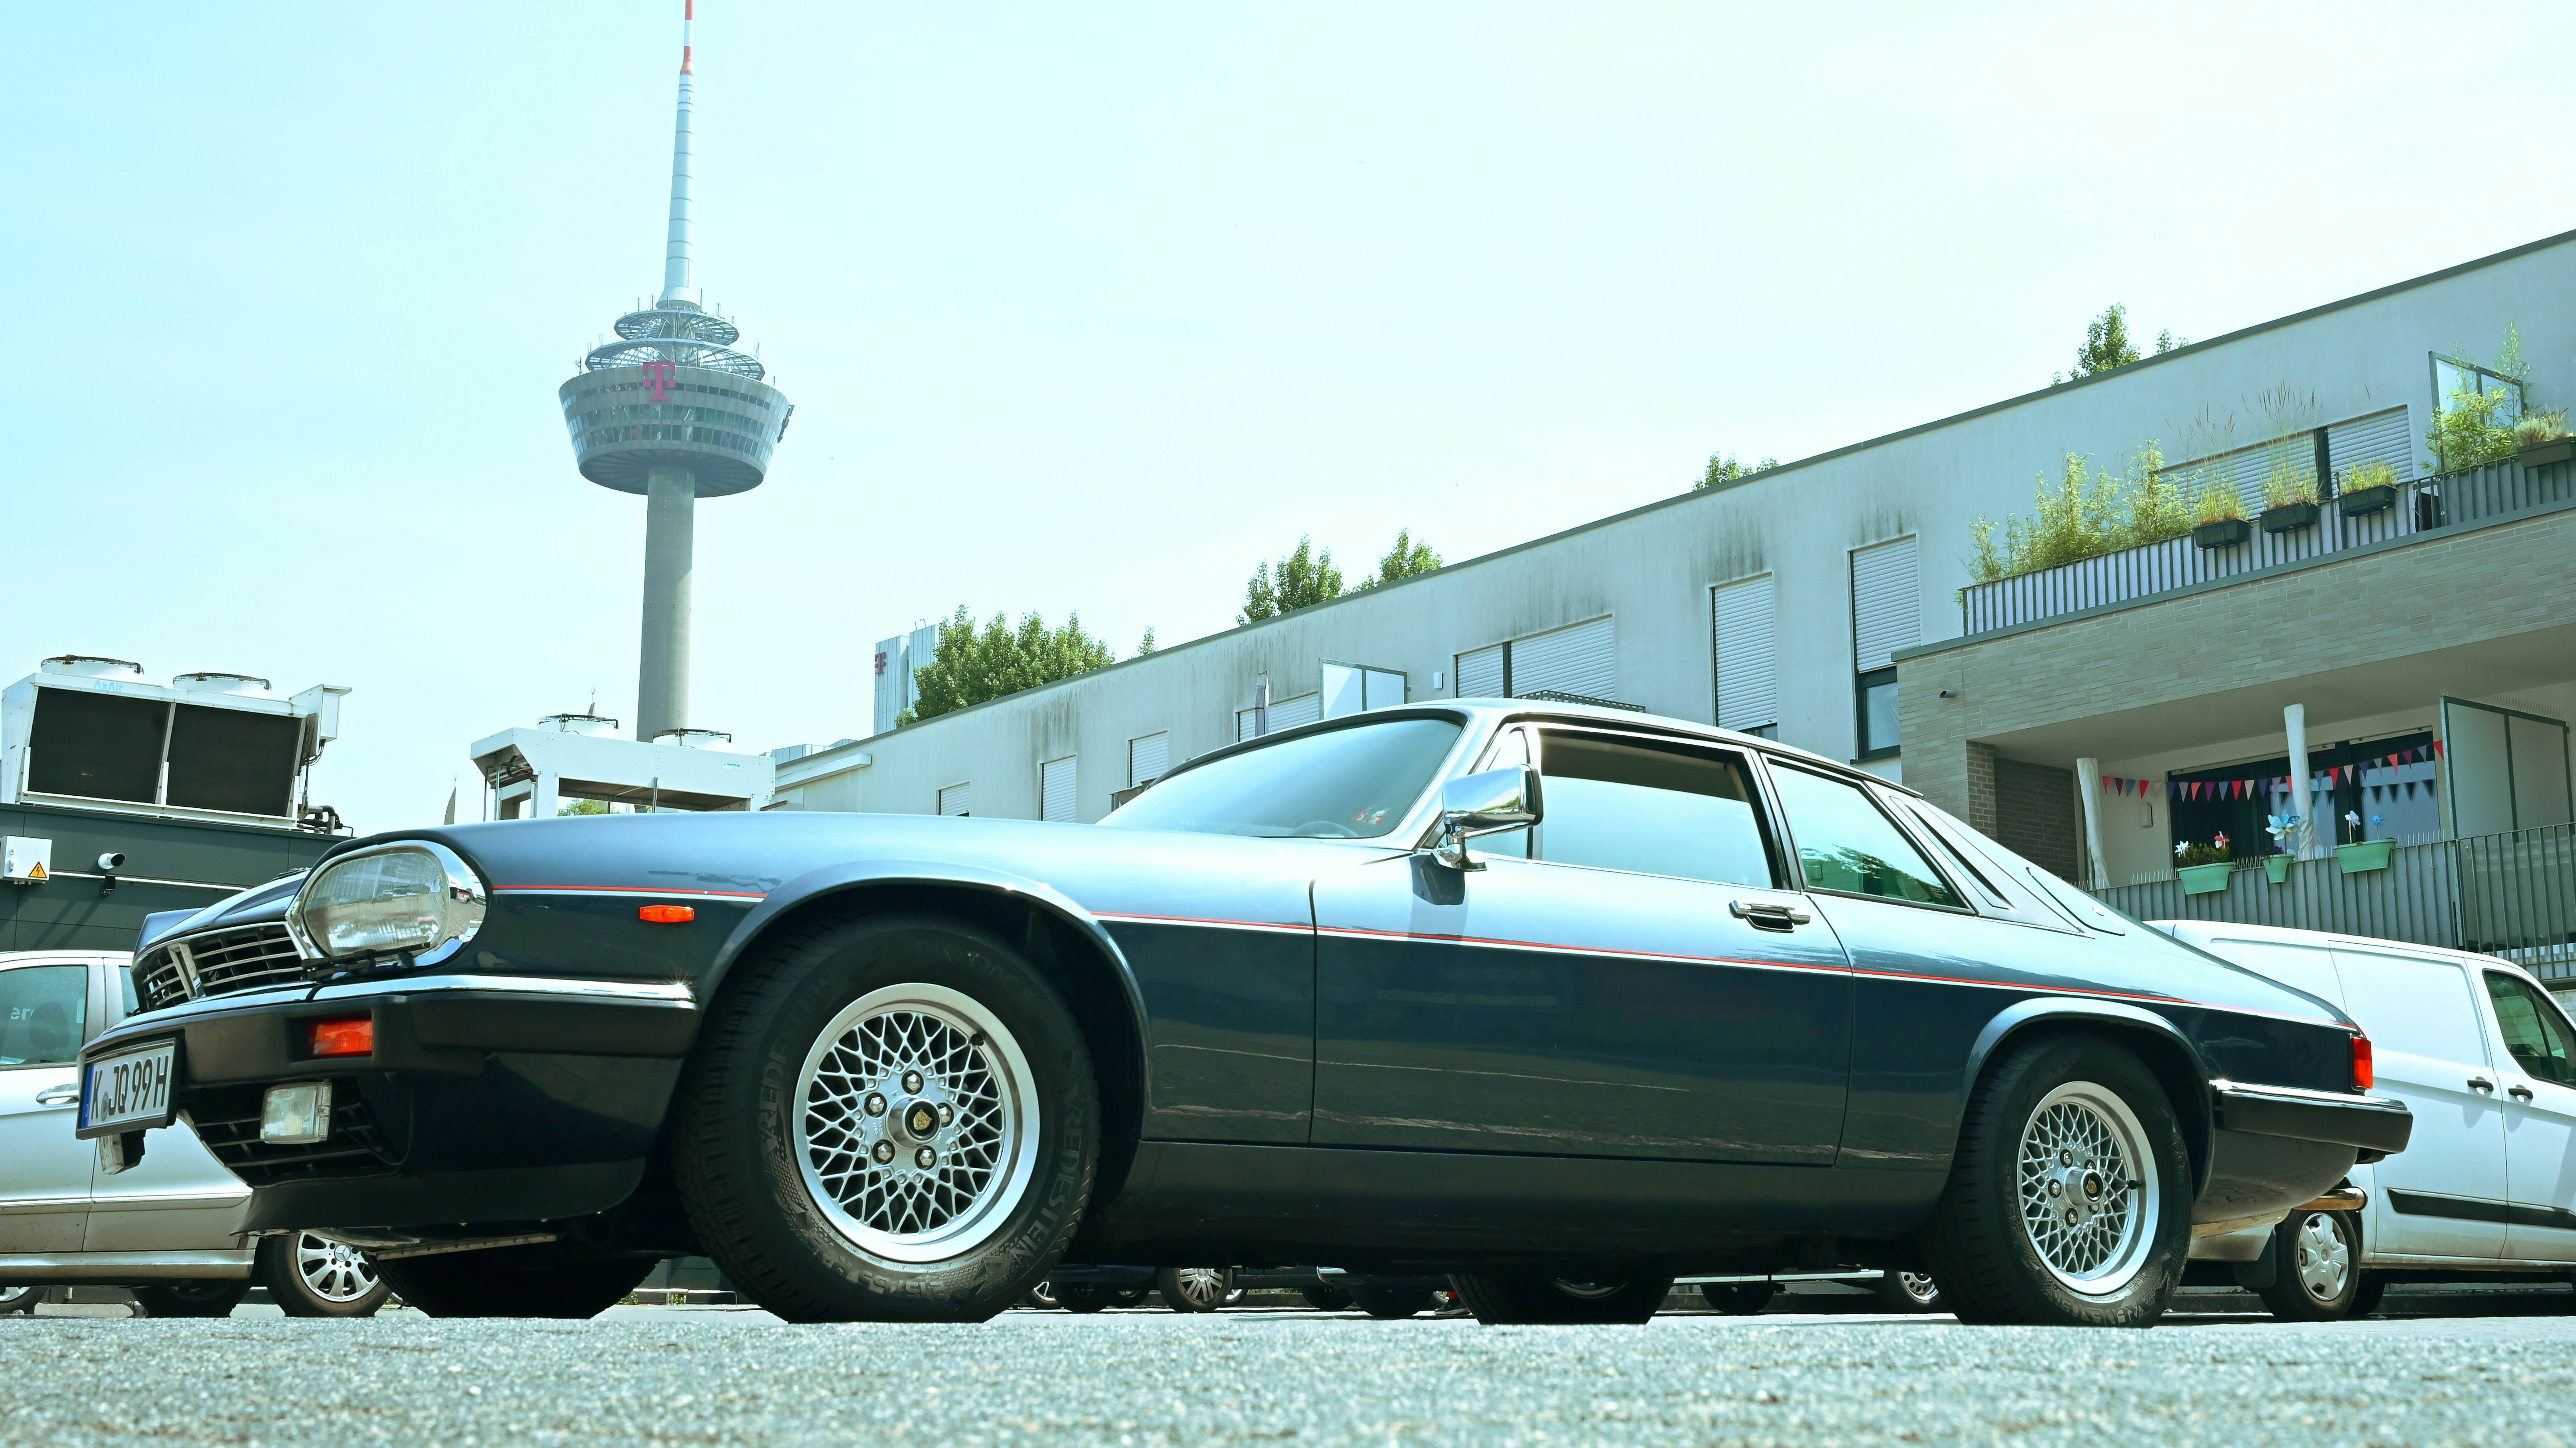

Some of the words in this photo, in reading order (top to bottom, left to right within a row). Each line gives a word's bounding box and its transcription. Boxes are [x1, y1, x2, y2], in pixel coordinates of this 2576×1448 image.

[643, 362, 676, 401] T
[874, 652, 887, 675] T
[93, 680, 123, 693] AxAir
[91, 1069, 103, 1119] K
[108, 1063, 130, 1116] JQ
[1009, 1084, 1083, 1265] VREDESTEIN
